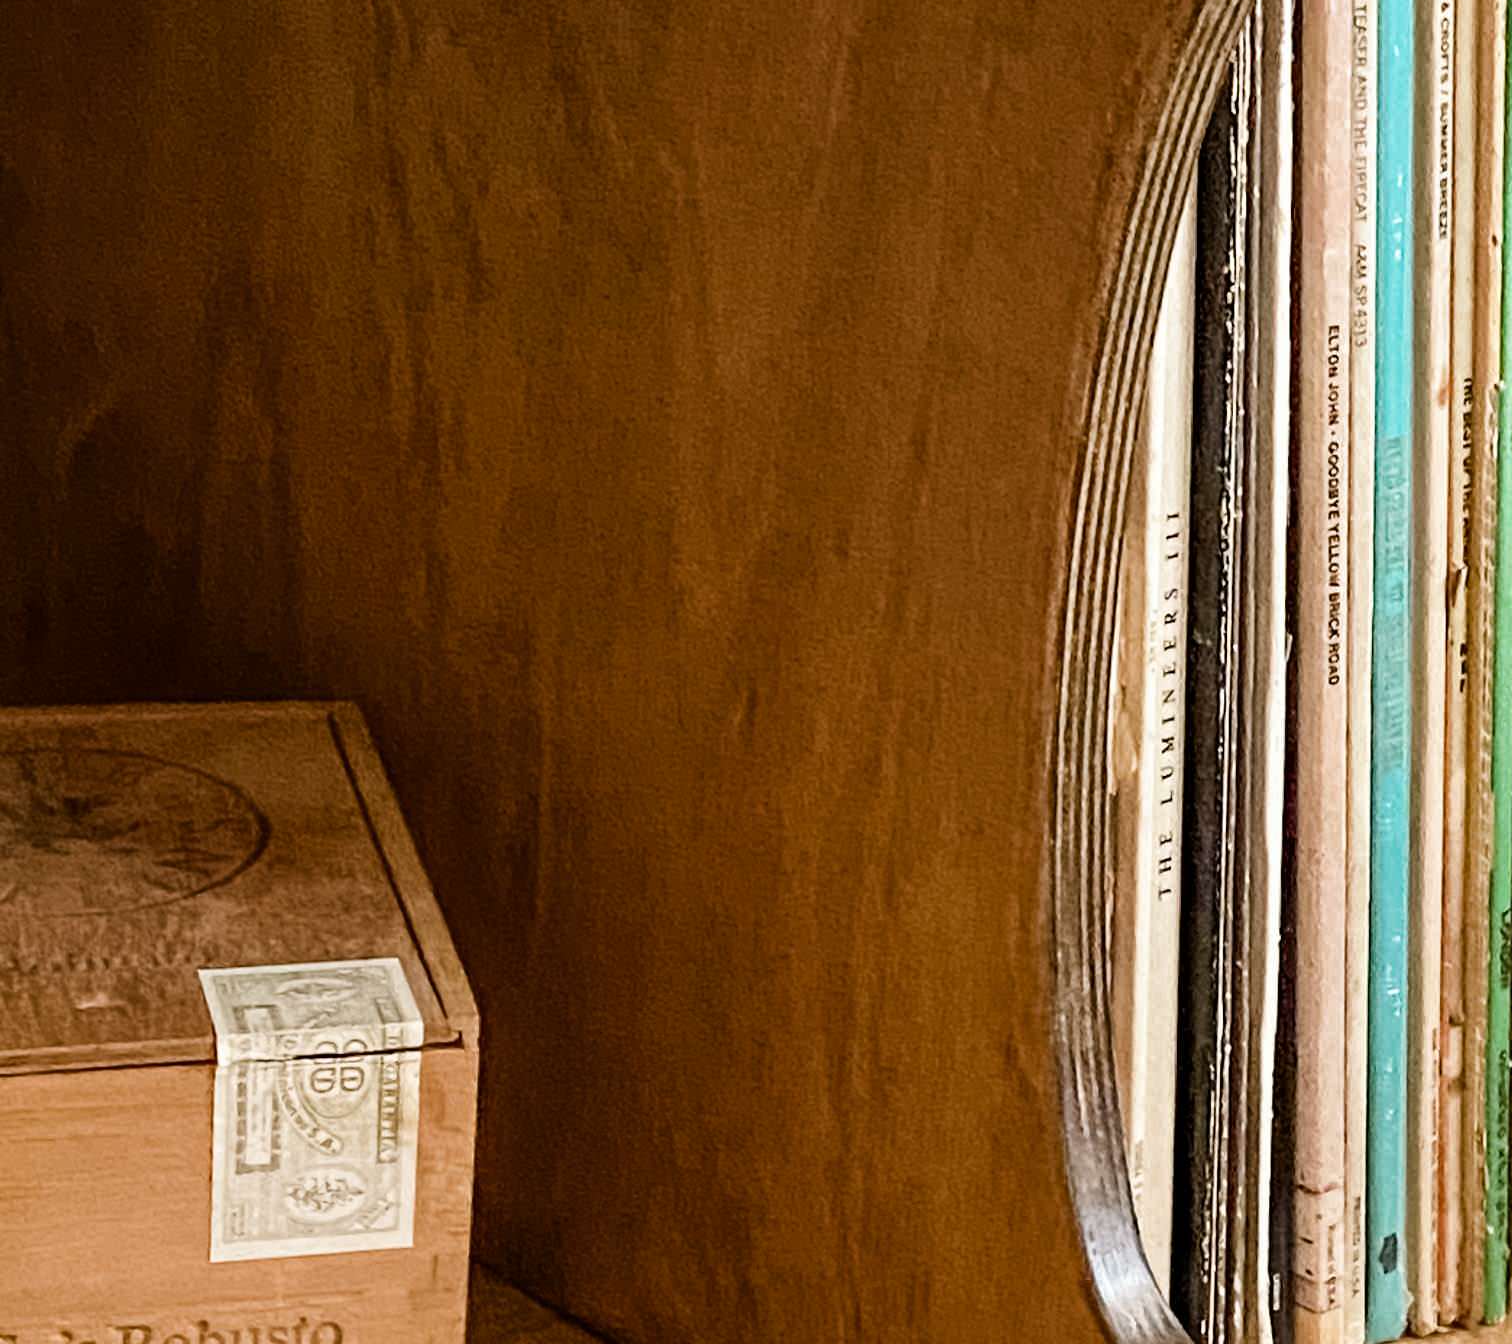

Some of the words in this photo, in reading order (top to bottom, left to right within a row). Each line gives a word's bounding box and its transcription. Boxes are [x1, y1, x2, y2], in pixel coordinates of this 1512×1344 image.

[1353, 5, 1367, 67] TEASER
[1439, 17, 1451, 85] CROFTS
[1353, 75, 1367, 110] AND
[1353, 118, 1367, 149] THE
[1438, 103, 1449, 174] SUMMER
[1437, 177, 1448, 240] BREEZE
[1354, 285, 1368, 305] SP
[1328, 325, 1340, 378] ELTON
[1328, 383, 1340, 426] JOHN
[1328, 441, 1340, 520] GOODBYE
[1165, 513, 1180, 561] III
[1327, 523, 1340, 587] YELLOW
[1327, 592, 1340, 638] BRICK
[1327, 644, 1340, 686] ROAD
[1160, 588, 1178, 805] LUMINEERS
[1158, 831, 1173, 901] THE
